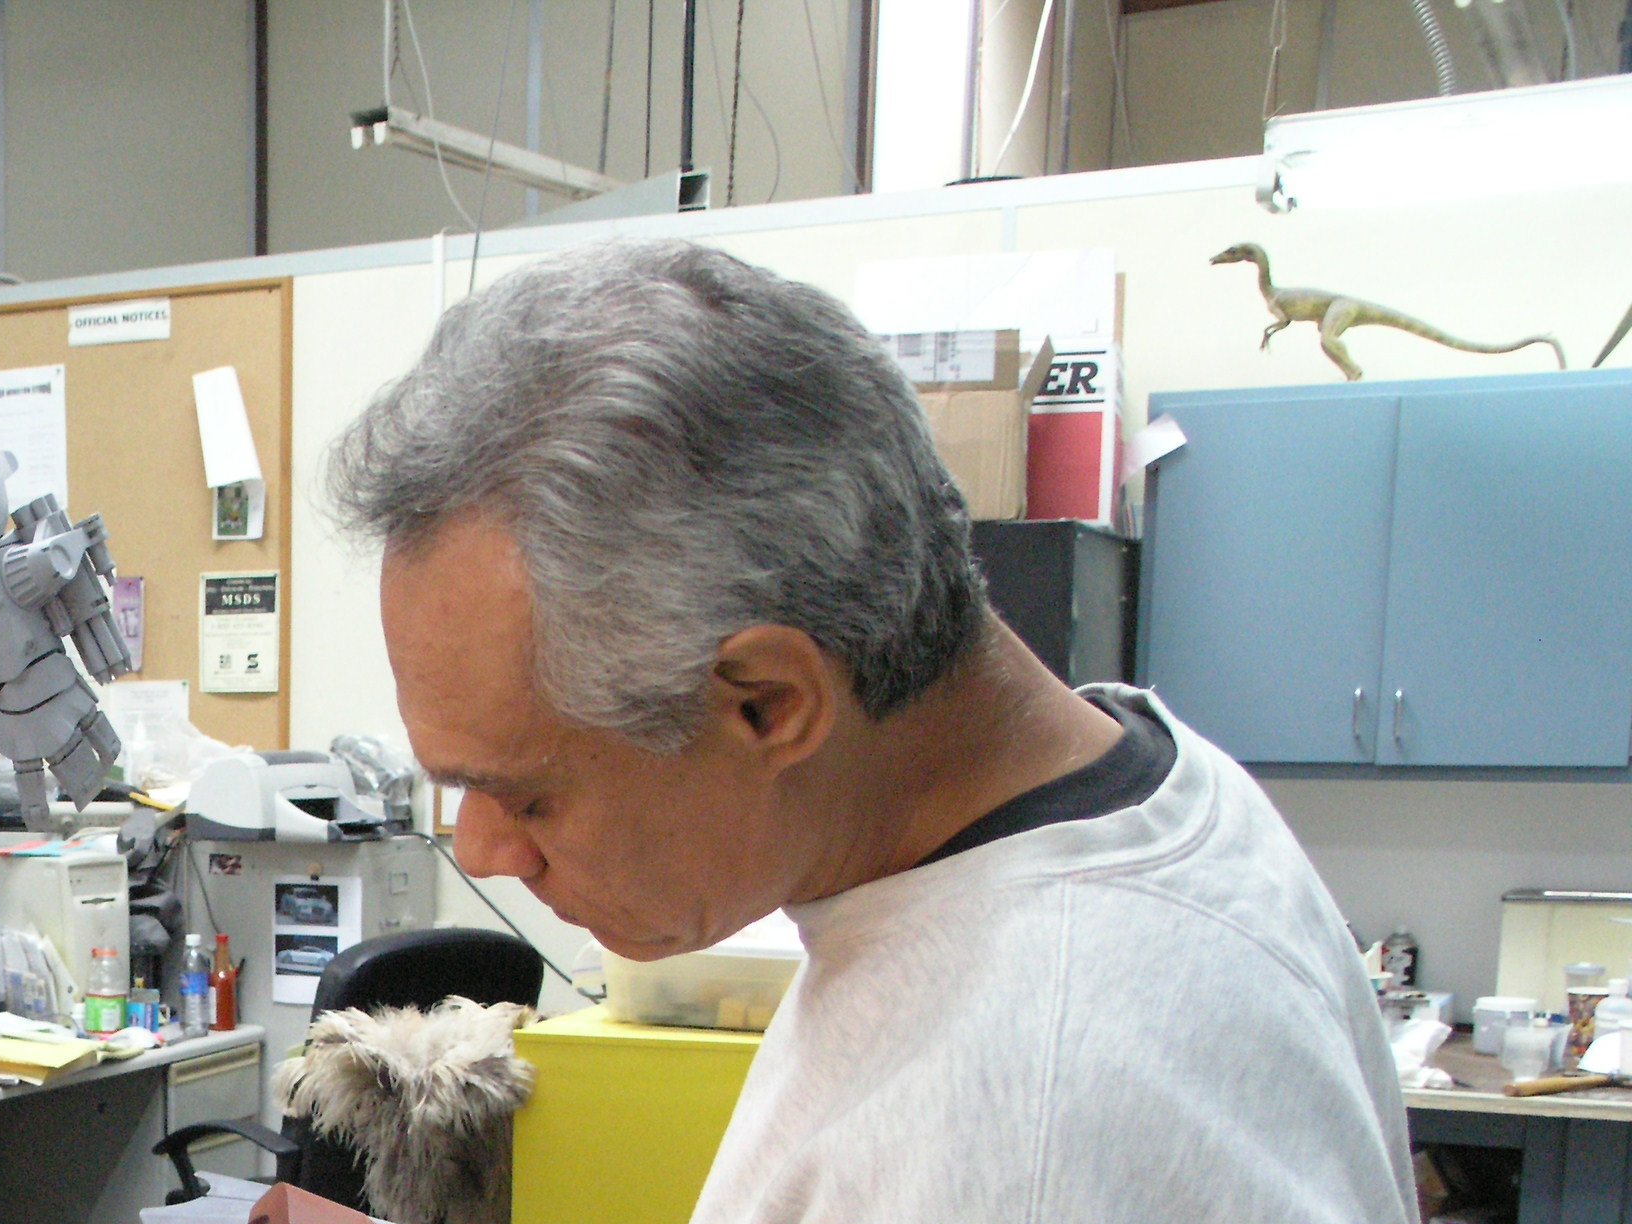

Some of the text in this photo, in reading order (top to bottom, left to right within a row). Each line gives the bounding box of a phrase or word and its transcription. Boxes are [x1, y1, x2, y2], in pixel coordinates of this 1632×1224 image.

[75, 309, 168, 328] OFFICIAL NOTICES
[221, 593, 262, 606] MSDS
